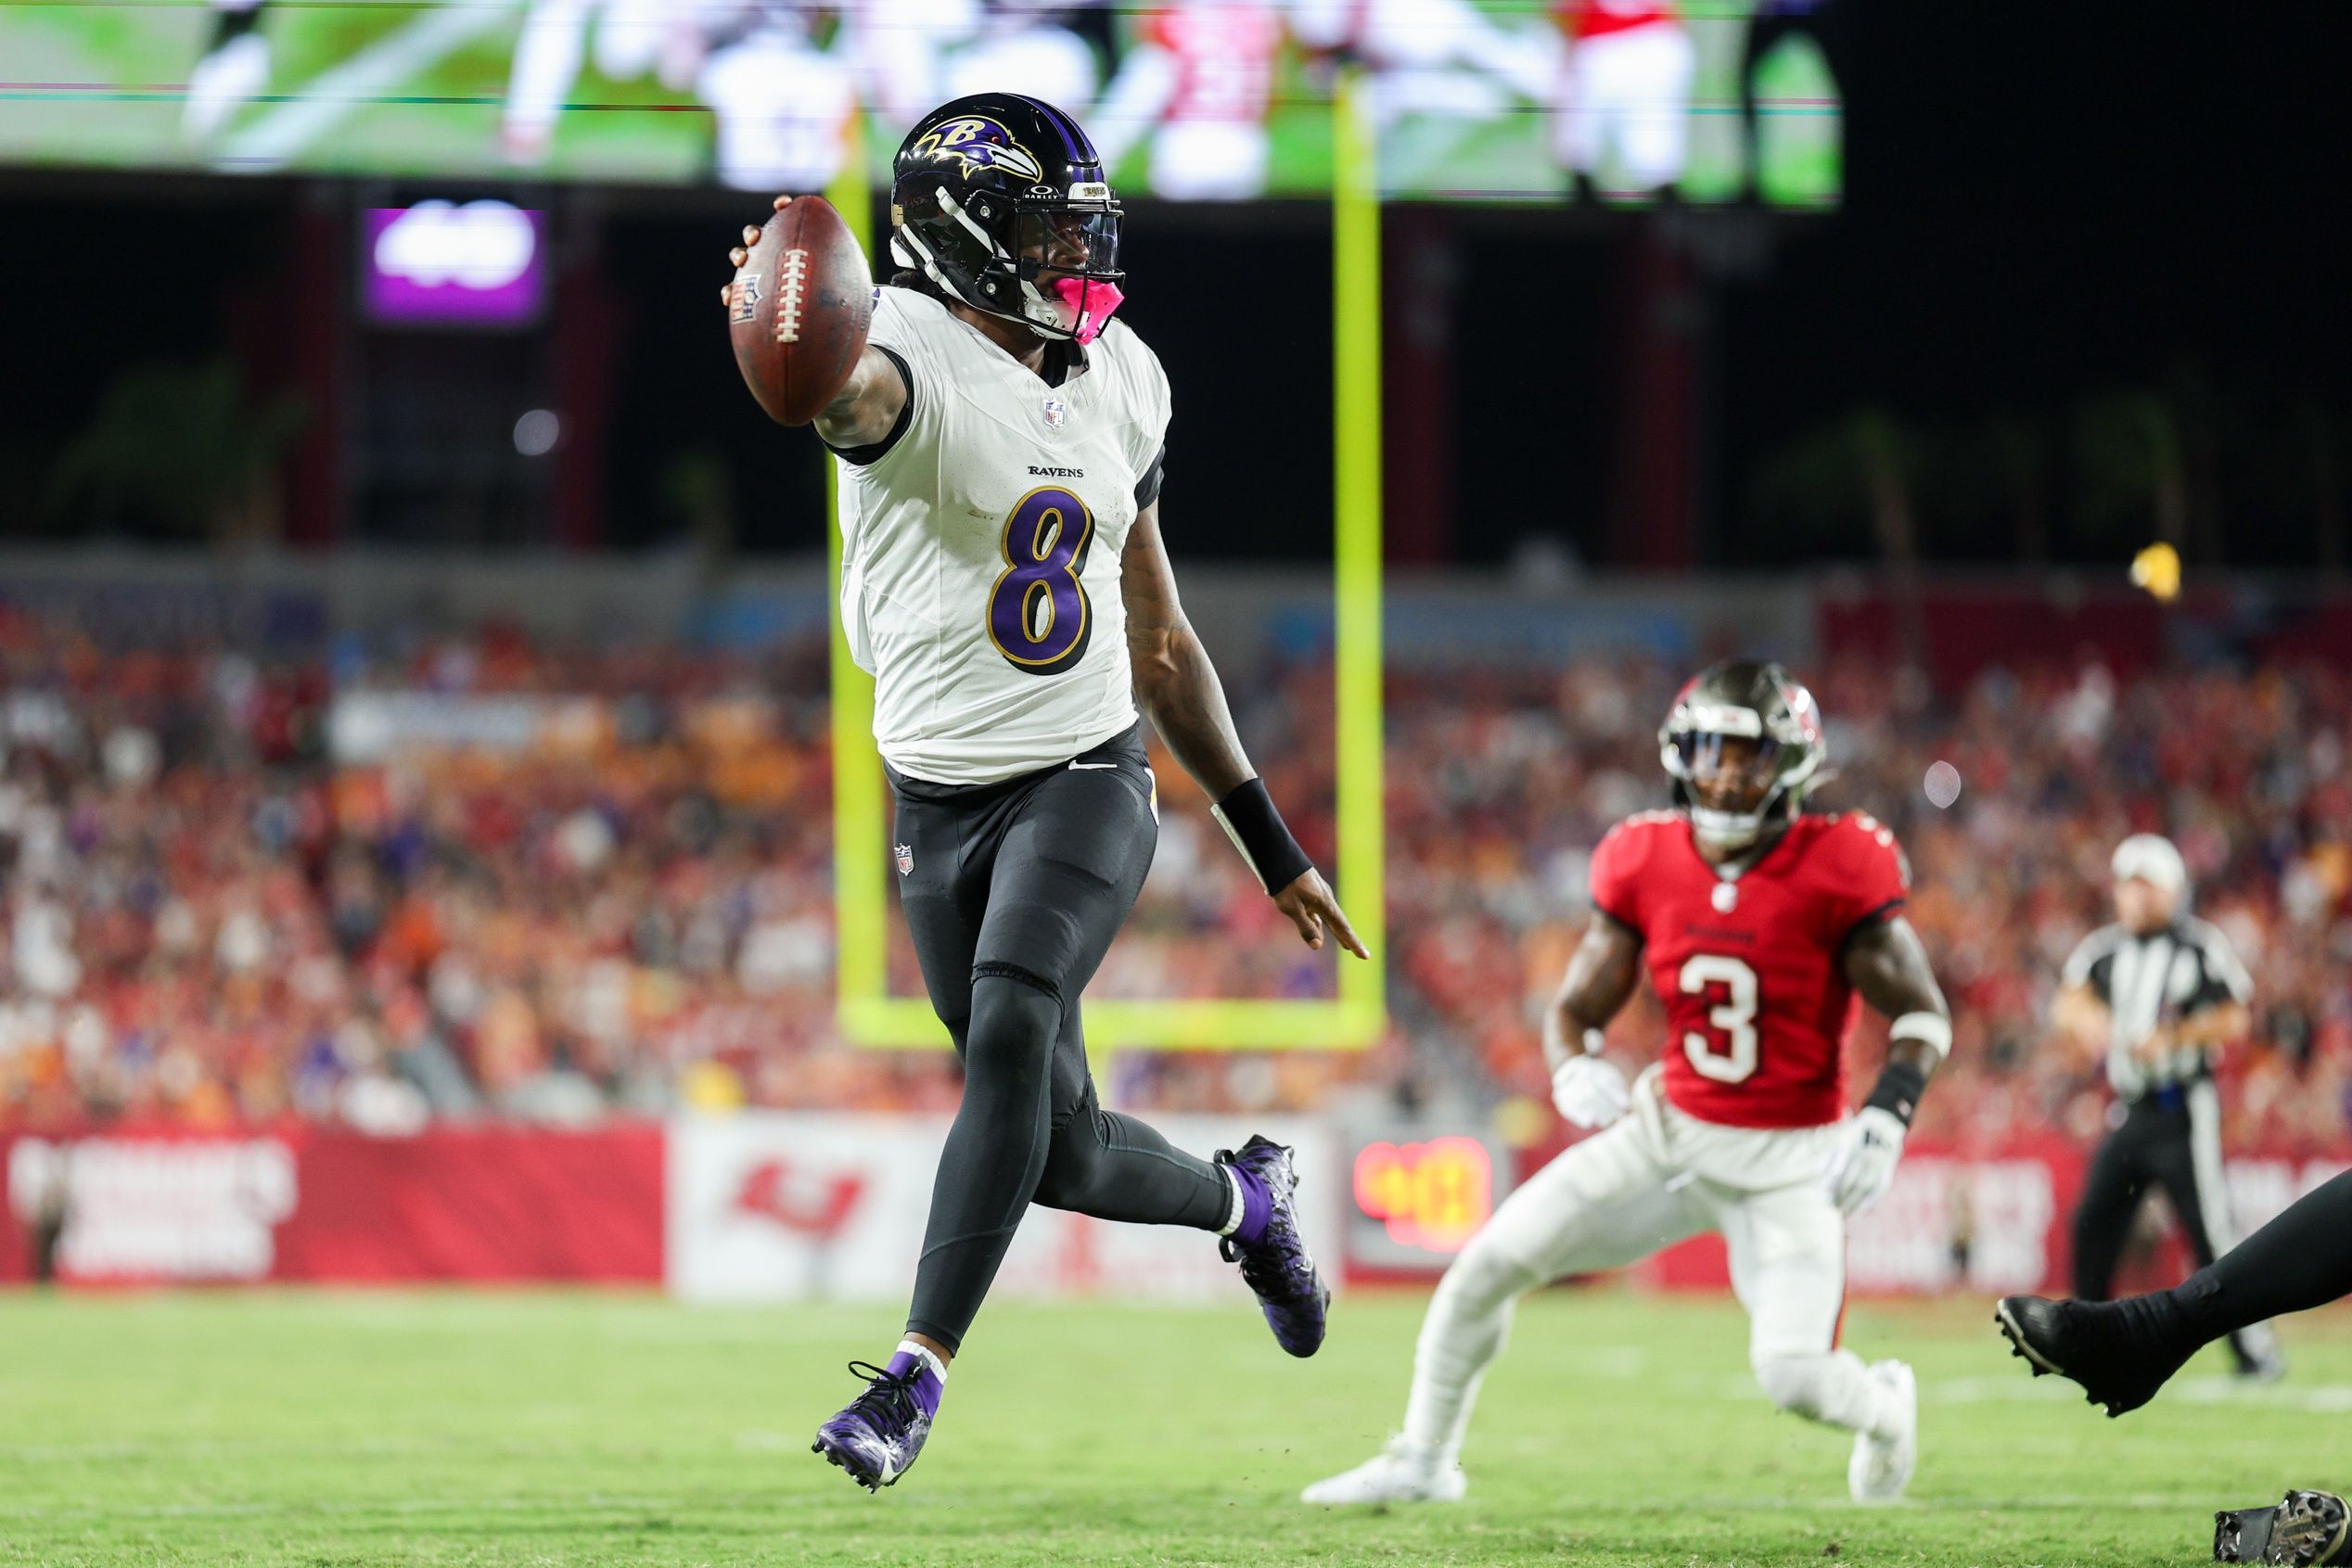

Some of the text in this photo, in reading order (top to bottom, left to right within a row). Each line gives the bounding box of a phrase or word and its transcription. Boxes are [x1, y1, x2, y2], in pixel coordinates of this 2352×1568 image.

[1046, 409, 1063, 425] NFL
[1027, 465, 1084, 478] RAVENS
[986, 485, 1095, 676] 8
[1678, 951, 1760, 1086] 3
